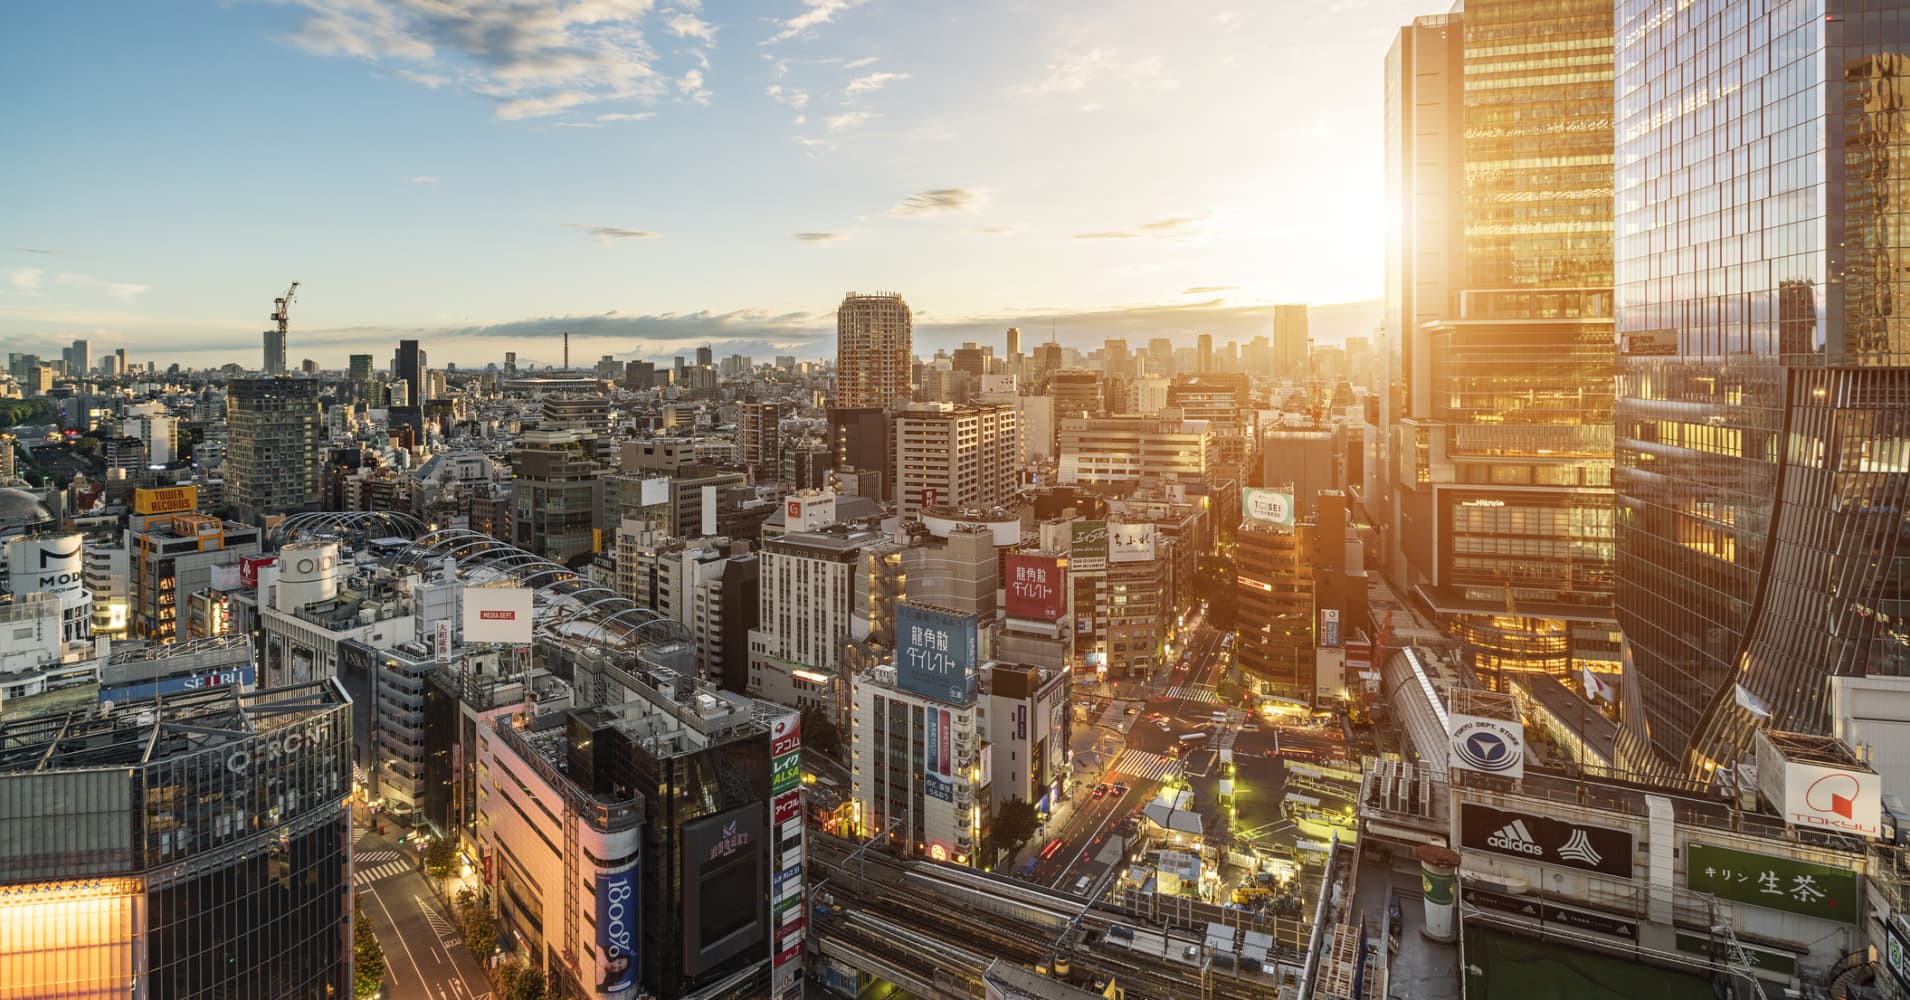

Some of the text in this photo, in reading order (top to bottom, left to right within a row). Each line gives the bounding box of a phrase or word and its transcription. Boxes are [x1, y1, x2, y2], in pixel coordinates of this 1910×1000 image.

[154, 489, 184, 501] TOWER
[151, 499, 190, 512] RECORDS
[911, 625, 949, 652] 龍角散
[1454, 721, 1519, 746] TOKYU DEPT. STORE
[774, 737, 800, 754] アコム
[774, 754, 799, 773] レイク
[773, 765, 799, 785] ALSA
[775, 799, 800, 815] アイフル
[1791, 813, 1877, 834] TOKYU
[1487, 836, 1543, 856] adidas
[1704, 866, 1826, 903] キリン 生茶
